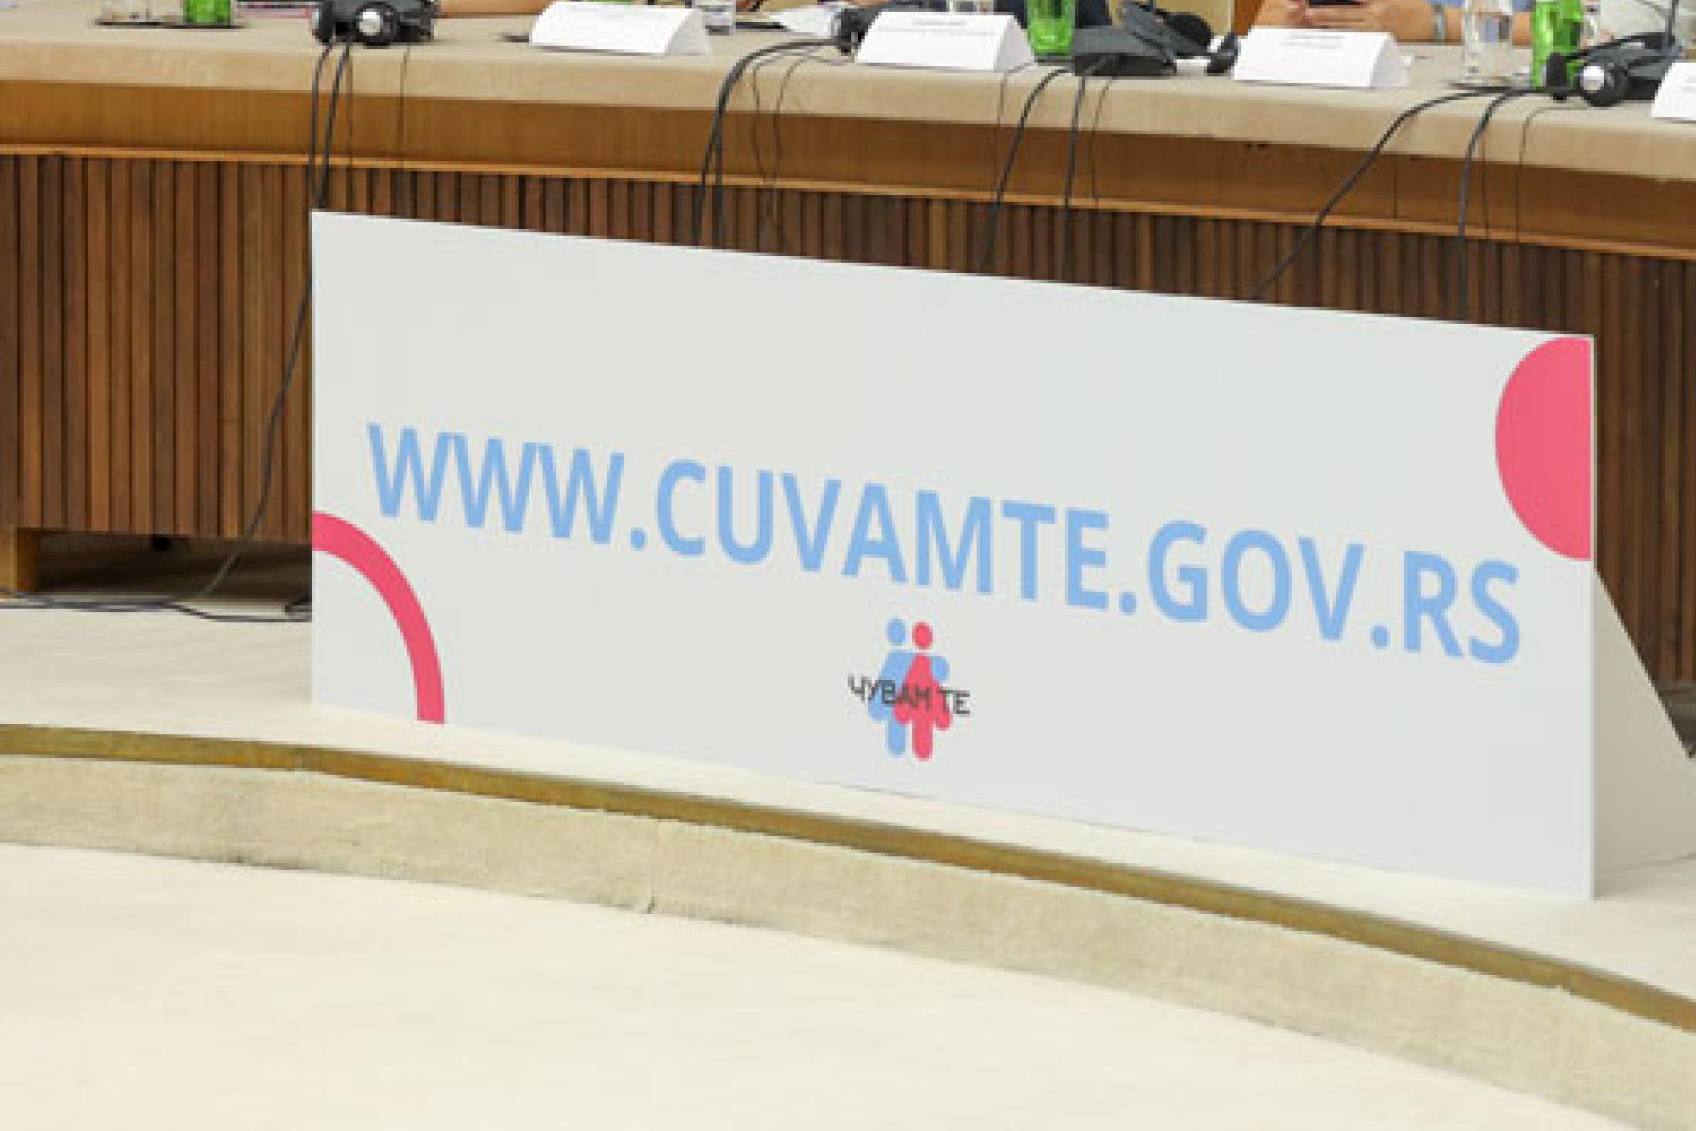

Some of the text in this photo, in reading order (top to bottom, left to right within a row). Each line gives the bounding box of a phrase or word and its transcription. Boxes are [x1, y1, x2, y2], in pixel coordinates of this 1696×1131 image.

[368, 420, 1522, 666] WWW.CUVAMTE.GOV.RS
[847, 674, 971, 716] ЧУВАМ ТЕ
